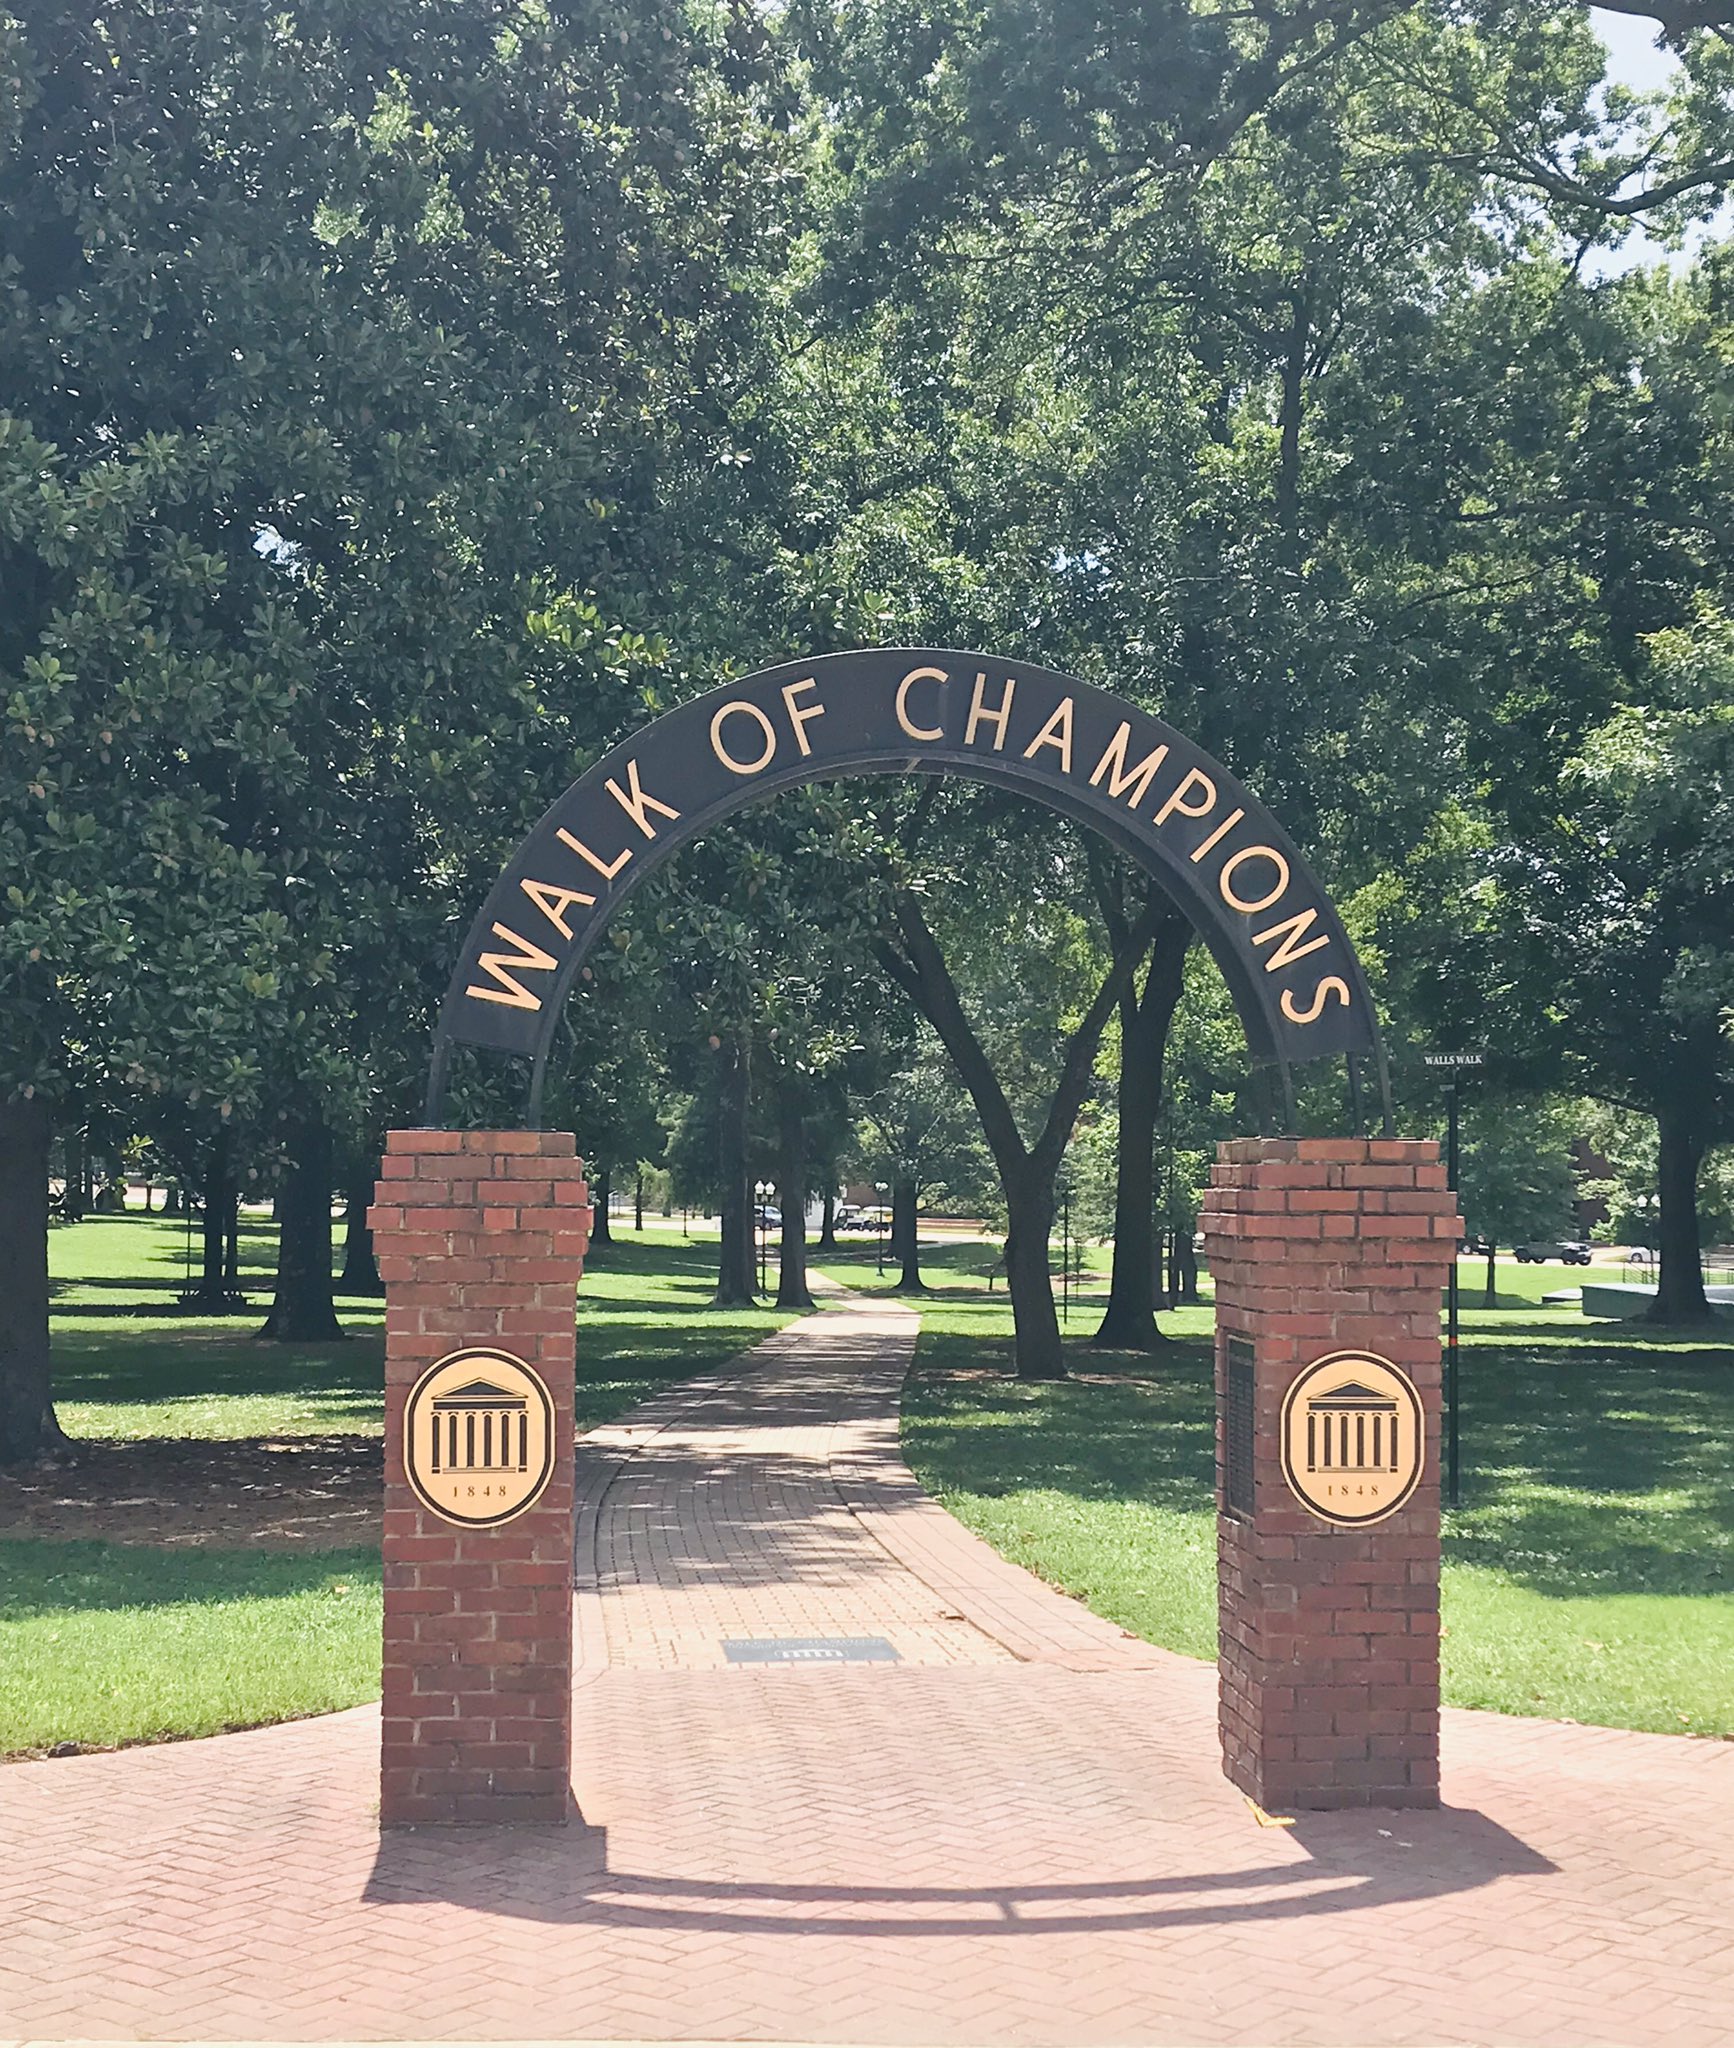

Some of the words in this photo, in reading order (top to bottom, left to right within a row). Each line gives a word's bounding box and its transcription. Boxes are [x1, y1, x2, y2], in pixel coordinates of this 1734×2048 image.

[467, 763, 679, 1011] WALK
[711, 679, 825, 775] OF
[896, 667, 1350, 1024] CHAMPIONS
[1424, 1055, 1455, 1065] WALLS
[1456, 1055, 1482, 1065] WALK
[453, 1485, 507, 1498] 1848
[1327, 1485, 1379, 1496] 1848
